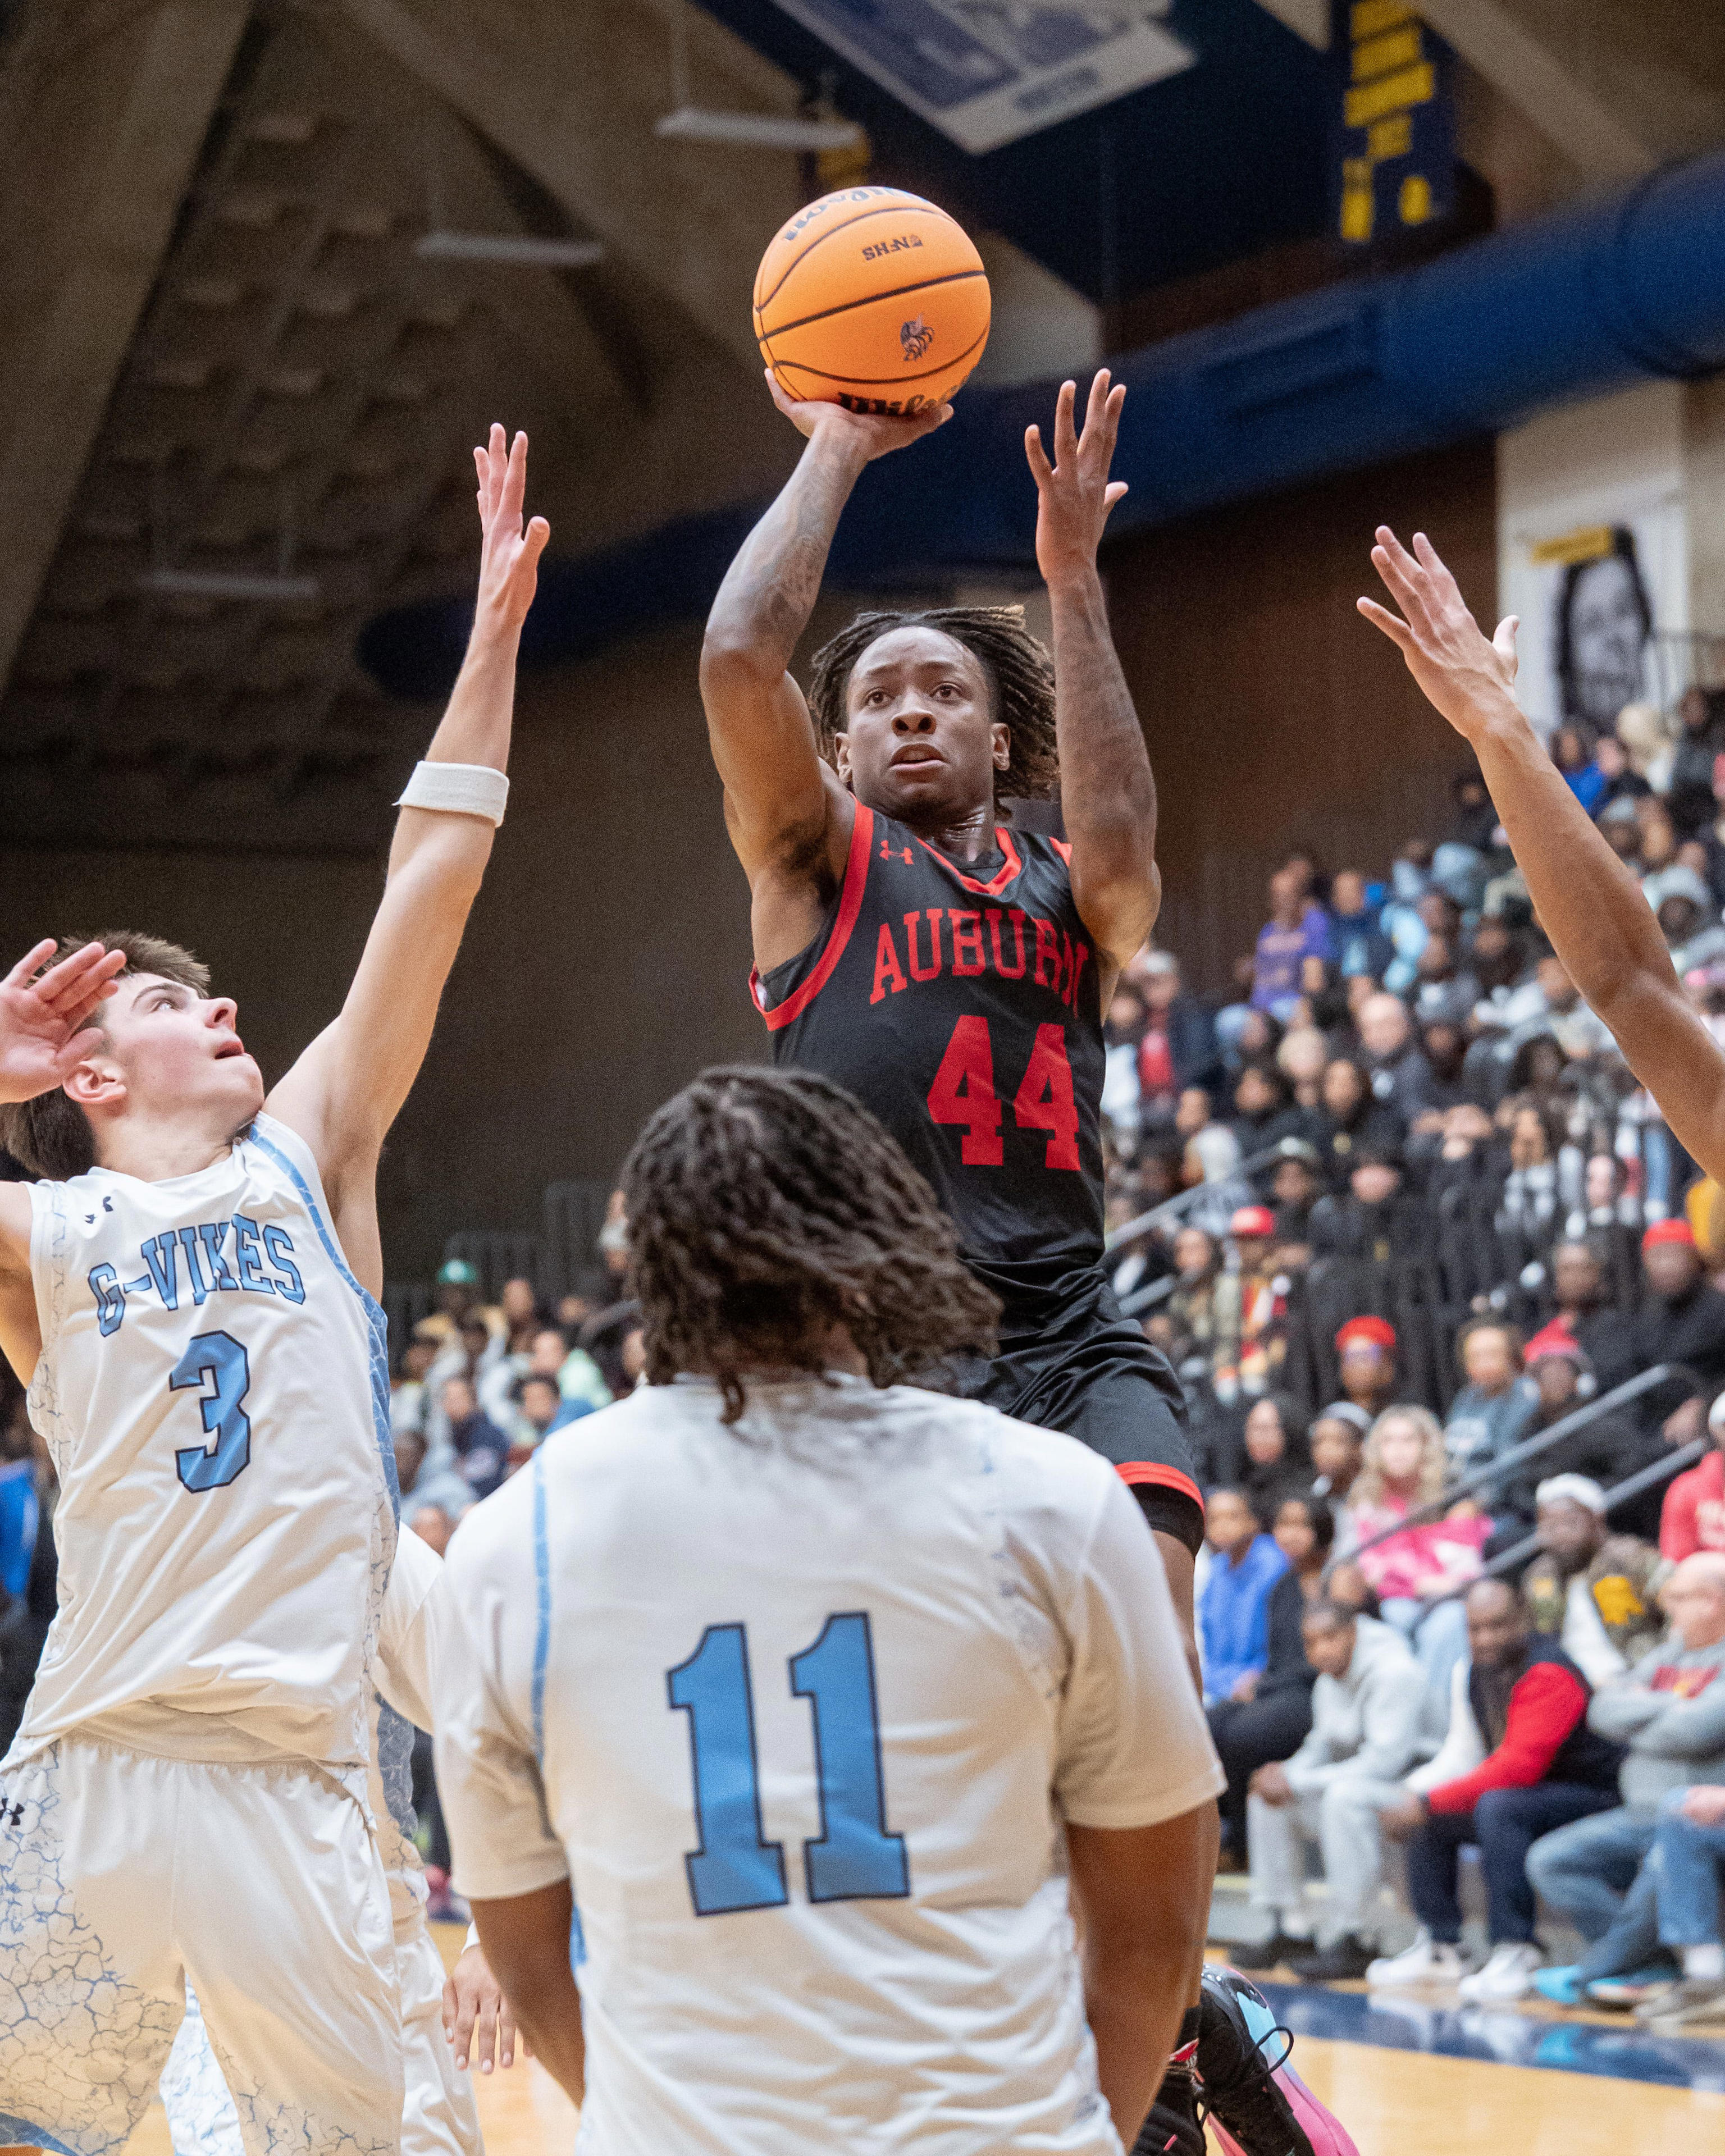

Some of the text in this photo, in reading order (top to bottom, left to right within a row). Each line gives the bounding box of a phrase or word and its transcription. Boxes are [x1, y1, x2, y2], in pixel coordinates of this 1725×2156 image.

[861, 236, 911, 261] NFHS
[869, 908, 1089, 1019] AUBURN
[927, 1015, 1081, 1171] 44
[88, 1213, 306, 1337] G-VIKES
[169, 1330, 251, 1493] 3
[666, 1611, 911, 1917] 11
